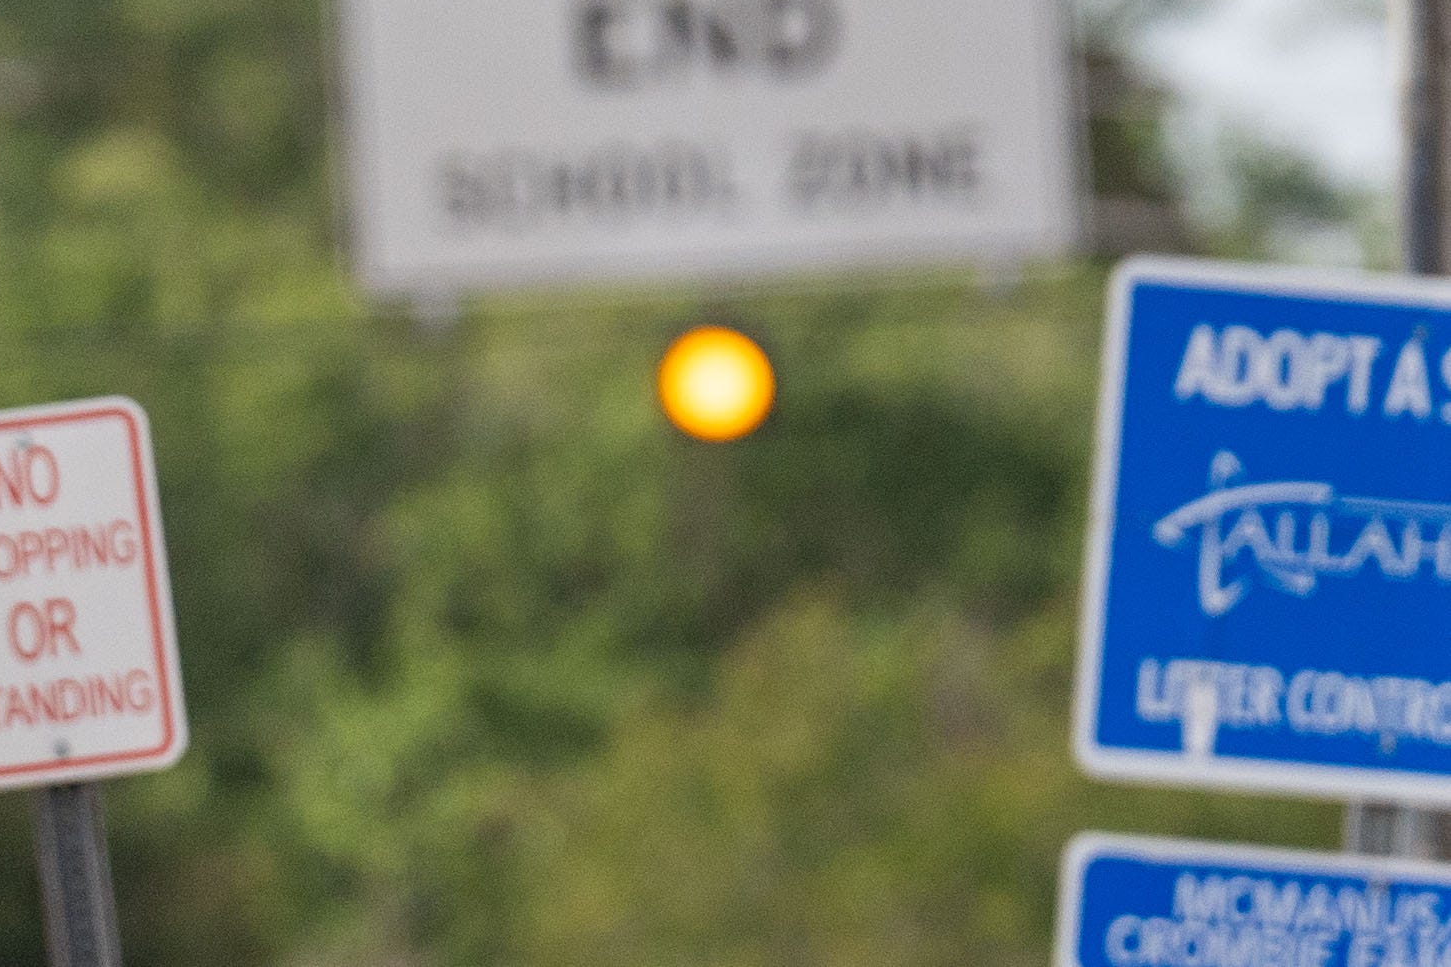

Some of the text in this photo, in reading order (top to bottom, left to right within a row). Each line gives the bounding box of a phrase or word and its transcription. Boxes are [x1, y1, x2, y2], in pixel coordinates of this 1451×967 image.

[435, 125, 991, 228] SCHOOL ZONE
[1174, 325, 1382, 414] ADOPT
[1383, 337, 1432, 420] A
[6, 596, 82, 665] OR
